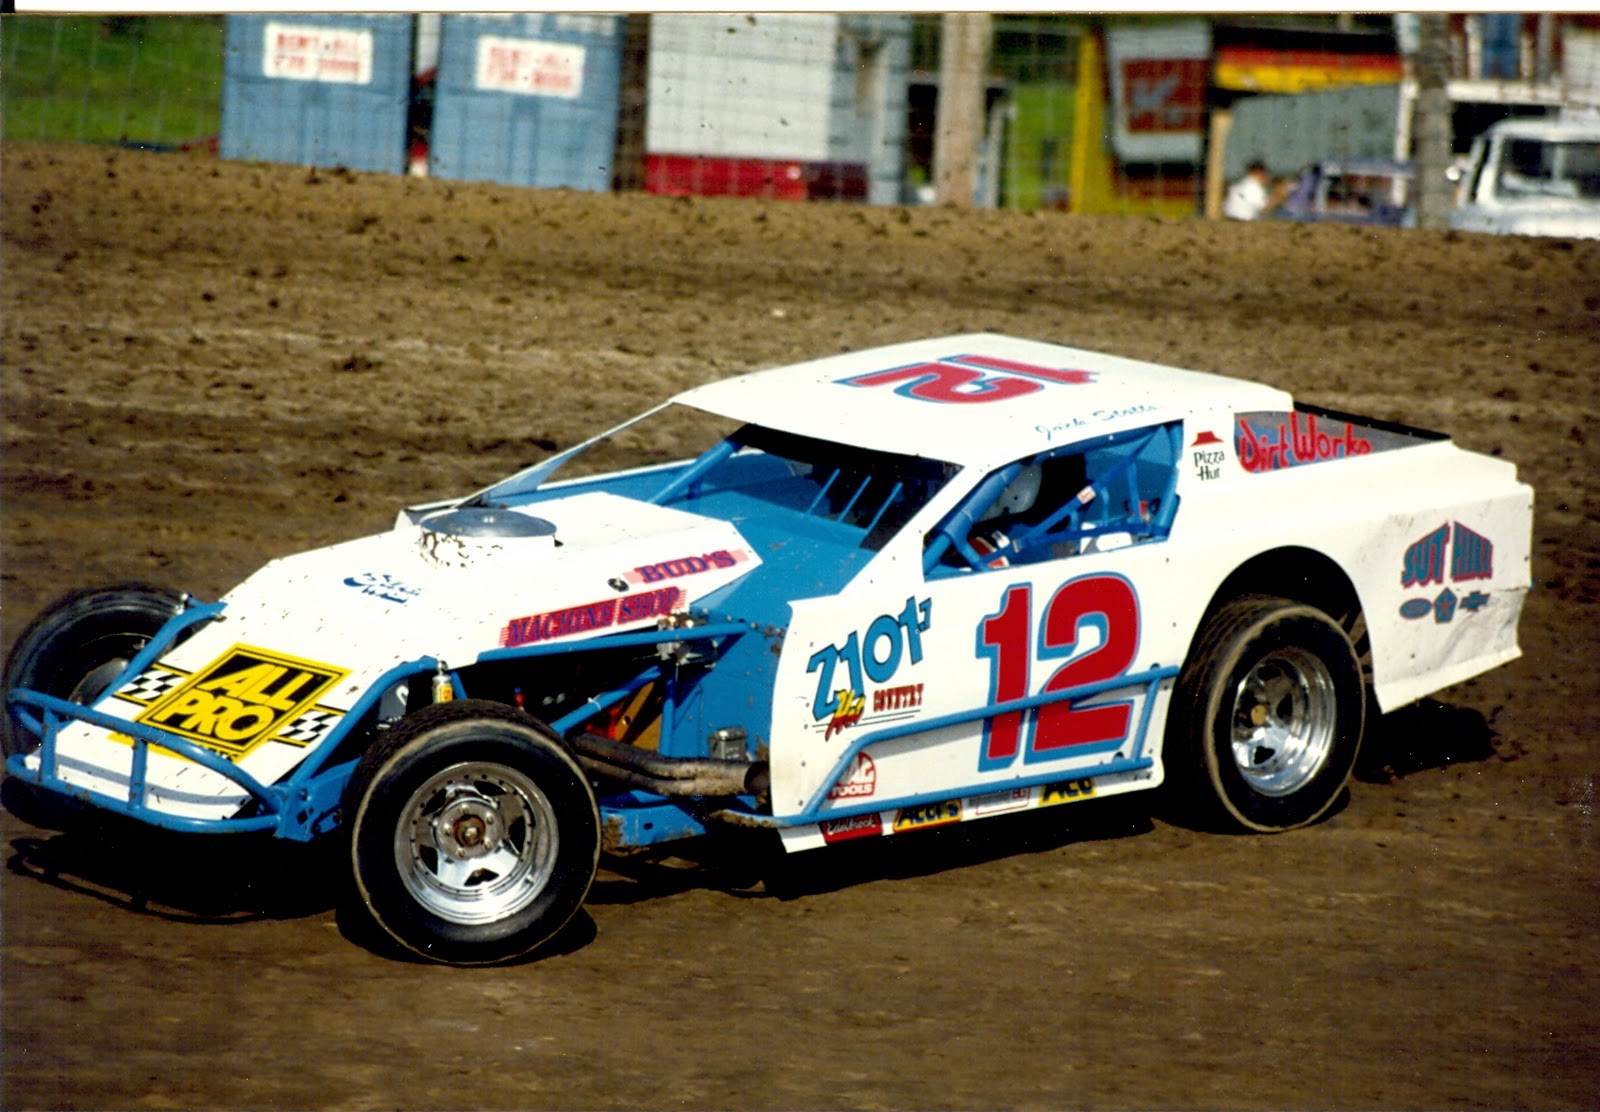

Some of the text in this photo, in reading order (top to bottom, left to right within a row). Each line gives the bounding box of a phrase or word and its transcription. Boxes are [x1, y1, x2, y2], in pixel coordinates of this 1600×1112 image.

[1193, 450, 1225, 468] Pizza
[1239, 416, 1290, 473] Dirt
[1196, 465, 1220, 481] Hut
[634, 550, 737, 584] BUD'S
[505, 586, 681, 647] MACHINE SHOP
[197, 662, 315, 711] ALL
[975, 571, 1142, 772] 12
[152, 690, 275, 741] PRO
[831, 782, 874, 798] TOOLS
